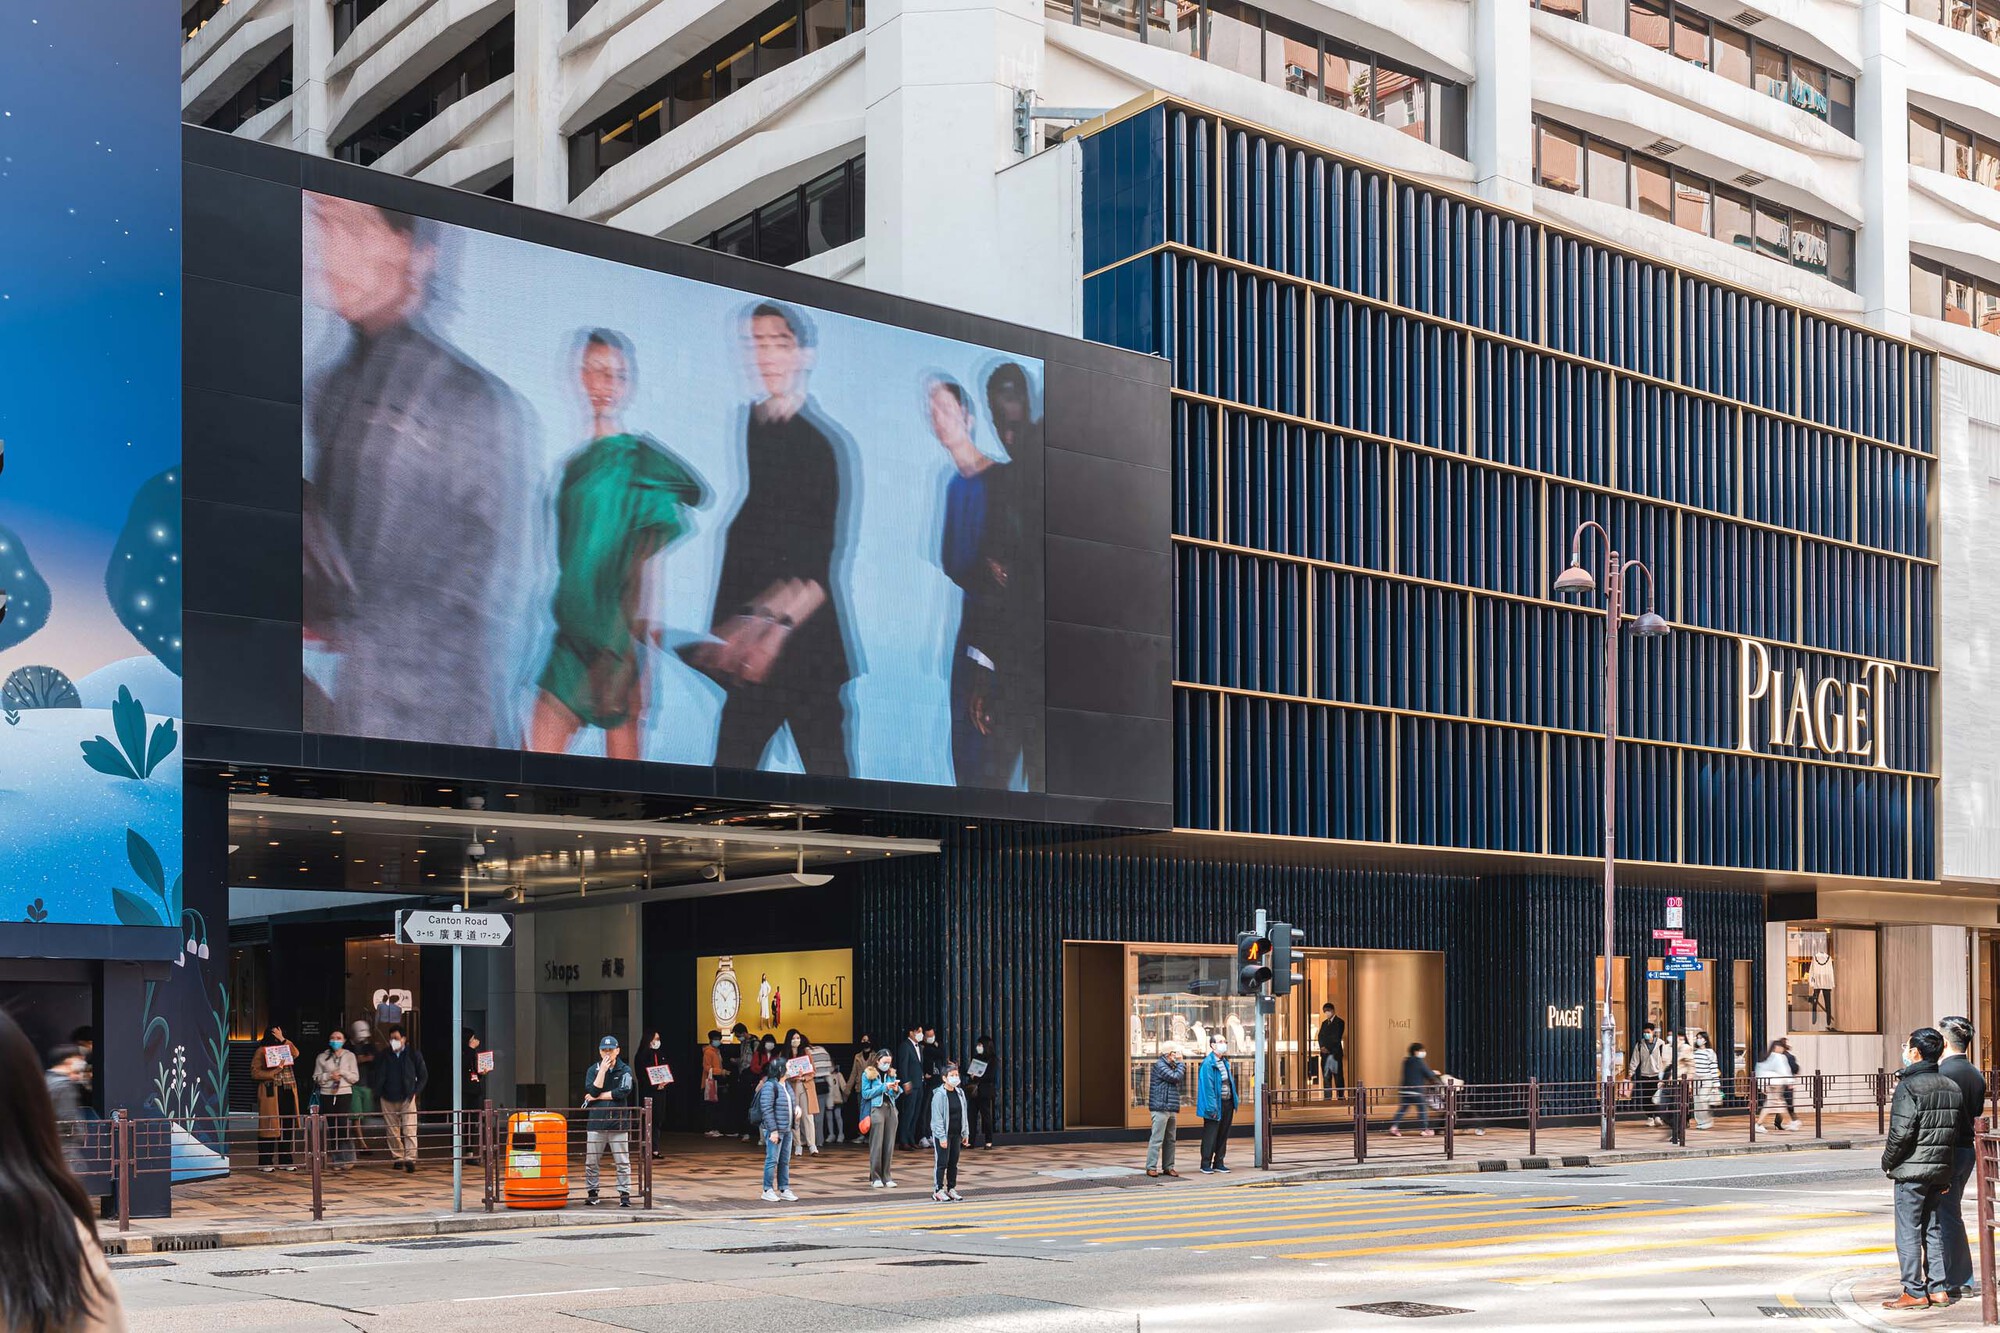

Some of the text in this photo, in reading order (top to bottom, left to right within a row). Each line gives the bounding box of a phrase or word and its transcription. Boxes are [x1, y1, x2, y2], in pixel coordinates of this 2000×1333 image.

[1735, 638, 1897, 769] PIAGET
[428, 915, 488, 926] Canton Road
[439, 929, 477, 940] 廣東道
[545, 960, 580, 986] Shops
[799, 975, 847, 1010] PIAGET
[1547, 1005, 1584, 1029] PIAGET
